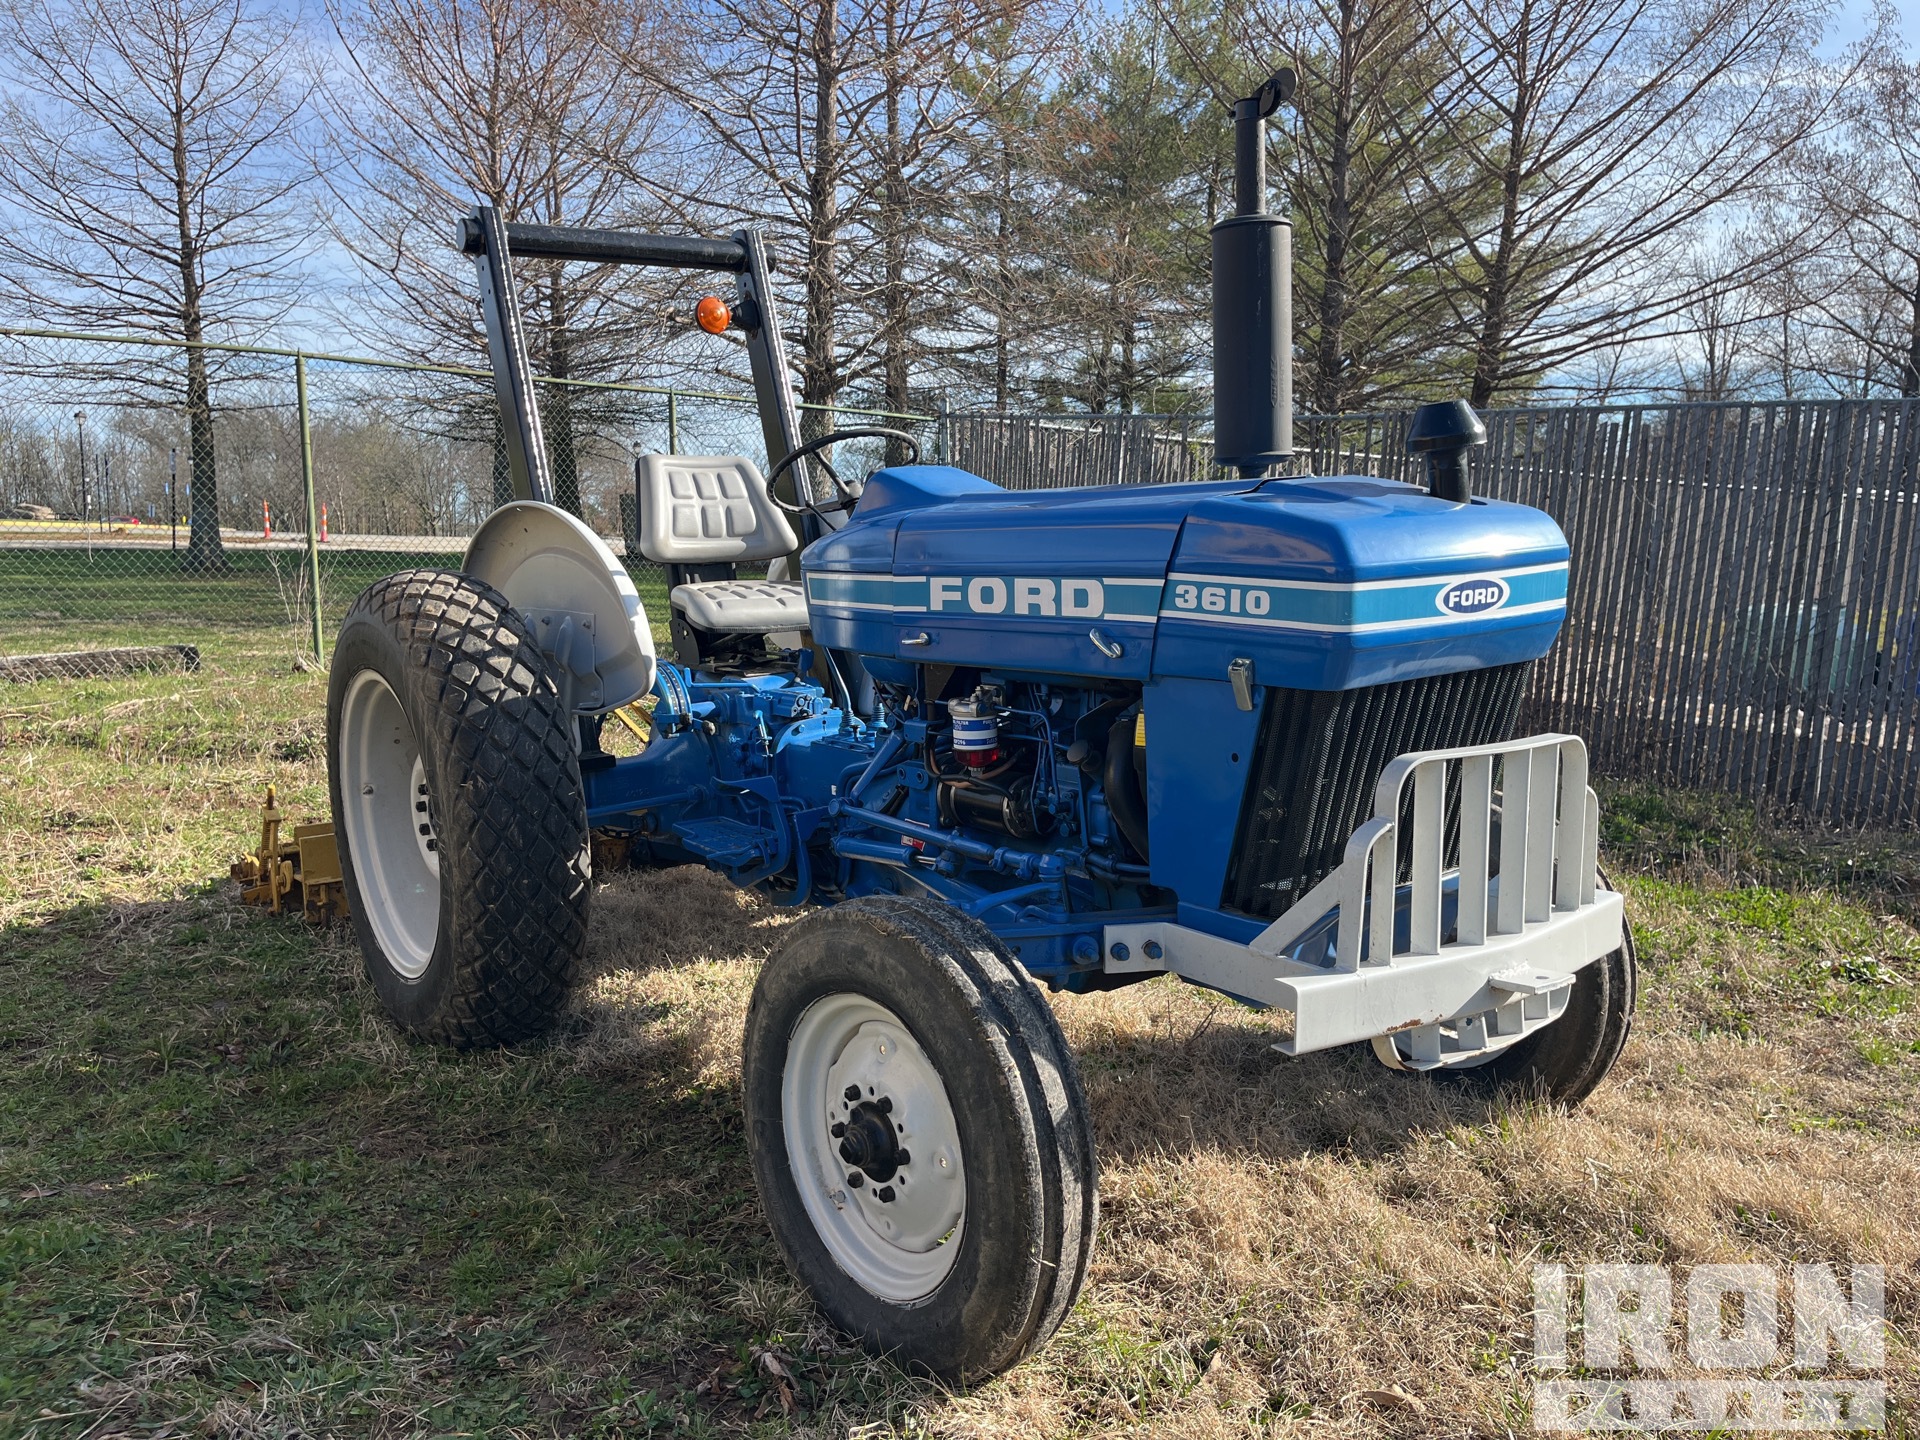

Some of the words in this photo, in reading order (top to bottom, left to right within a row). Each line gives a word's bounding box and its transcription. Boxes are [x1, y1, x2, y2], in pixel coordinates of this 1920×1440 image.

[929, 577, 1105, 618] FORD
[1174, 584, 1270, 616] 3610
[1448, 586, 1499, 608] FORD
